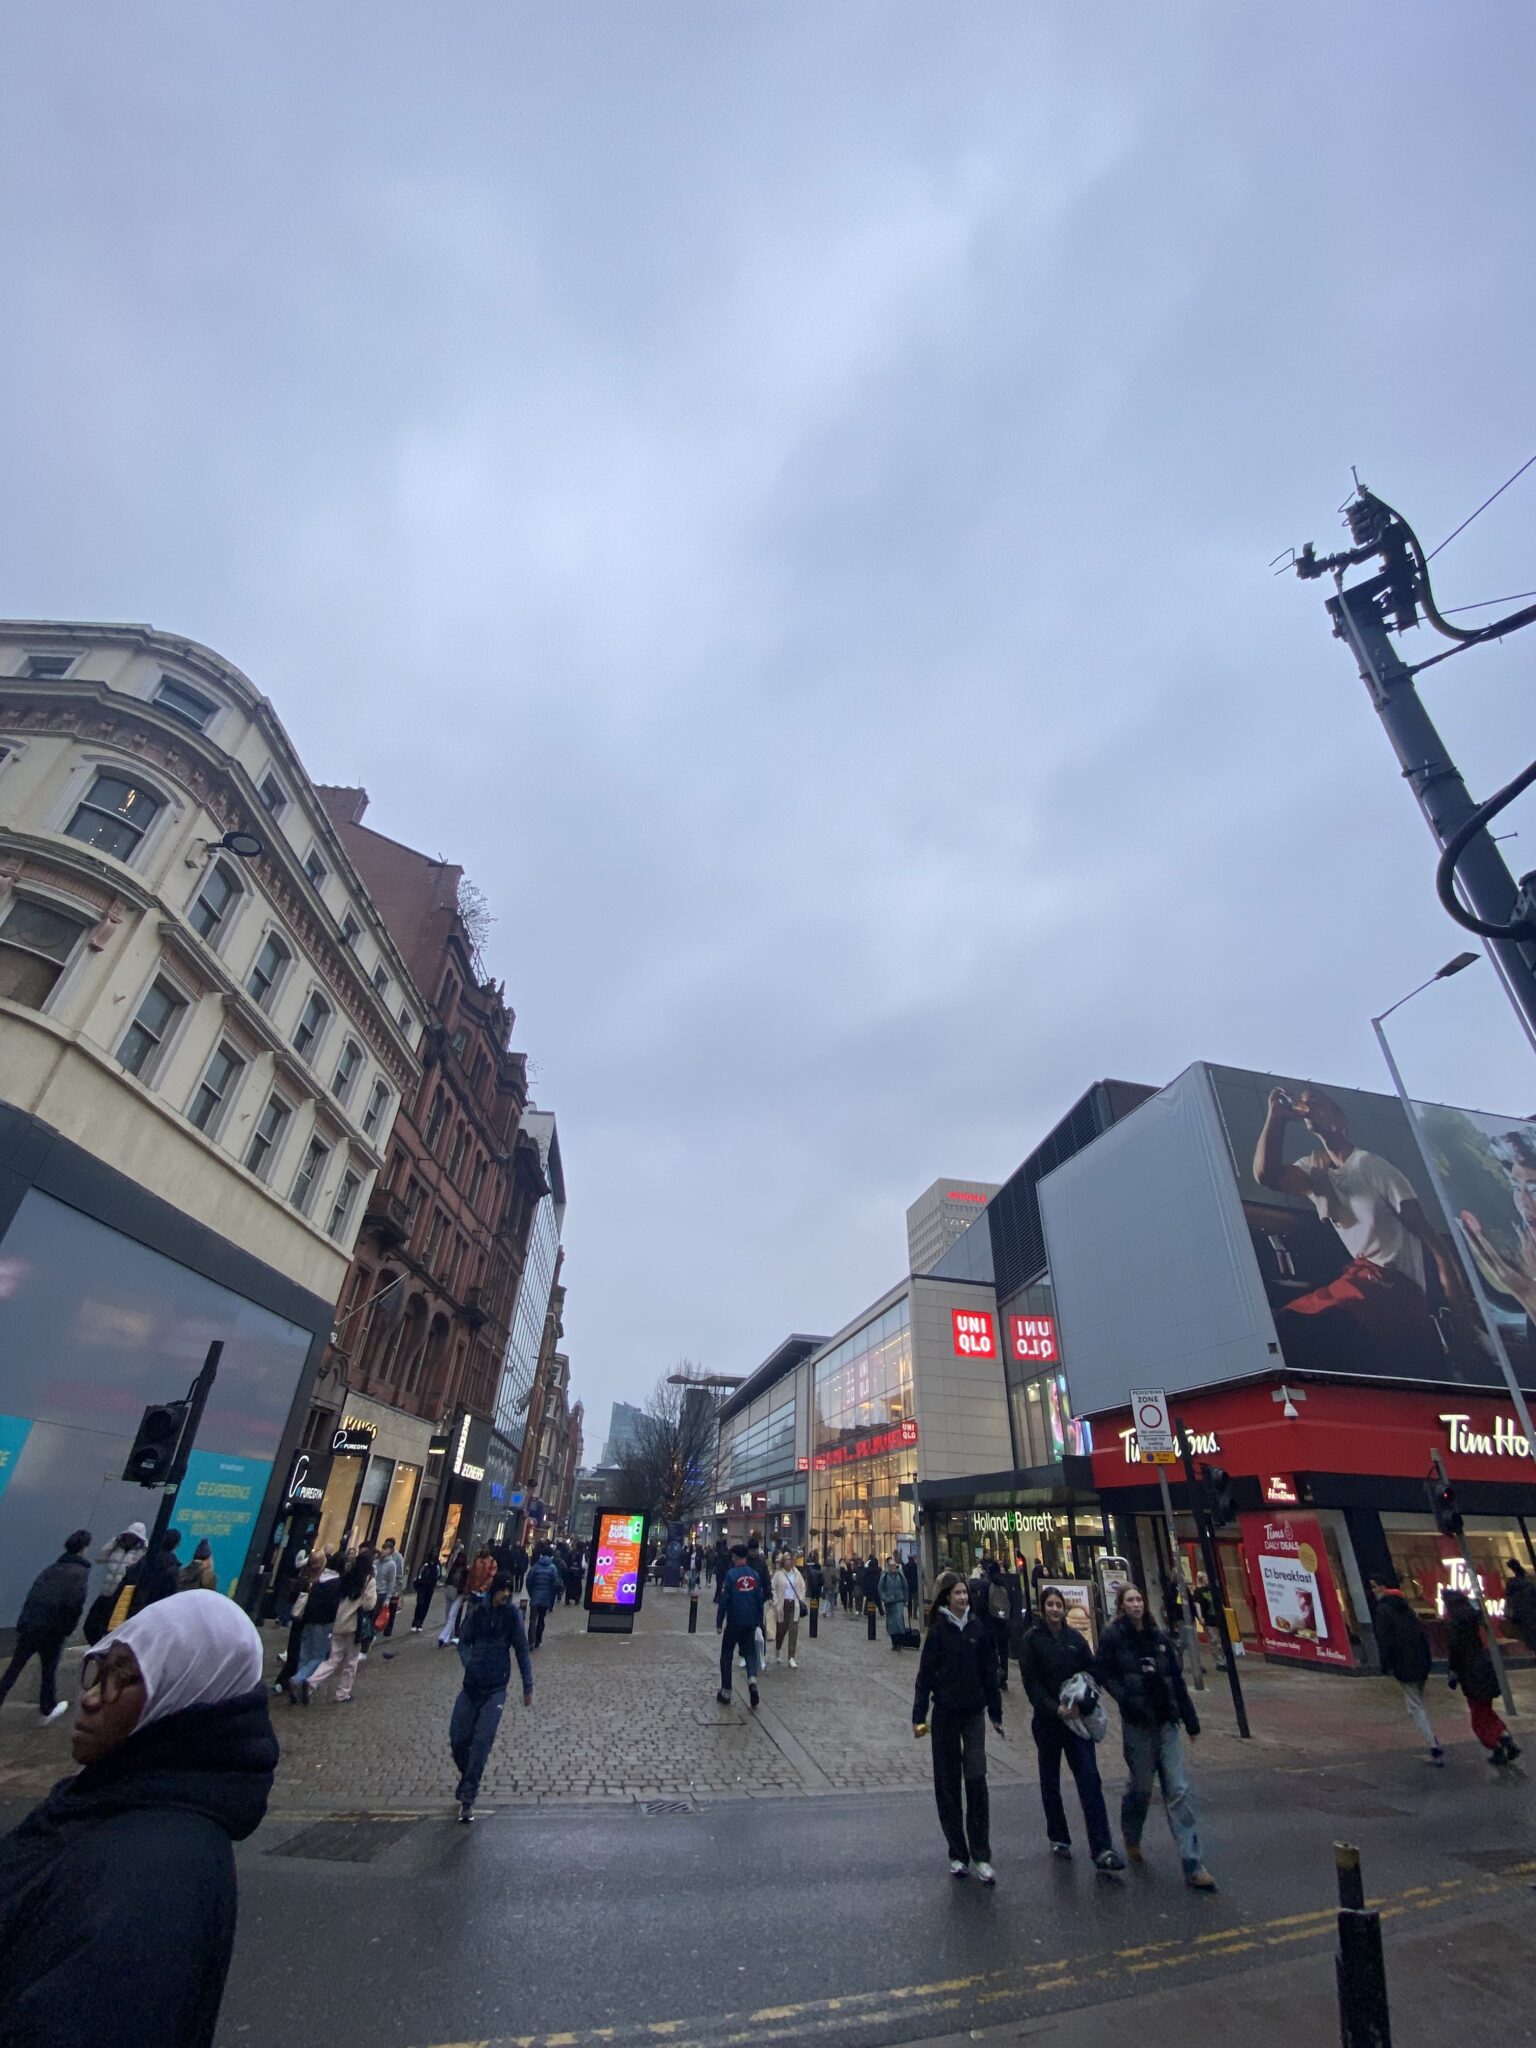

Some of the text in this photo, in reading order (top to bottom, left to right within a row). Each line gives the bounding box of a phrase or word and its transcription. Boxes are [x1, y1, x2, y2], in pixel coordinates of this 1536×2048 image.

[957, 1315, 987, 1334] UNI
[959, 1334, 991, 1354] QLO
[902, 1423, 915, 1431] UNI
[902, 1431, 916, 1439] QLO
[1439, 1414, 1493, 1456] Tim
[1270, 1477, 1287, 1490] Tim
[300, 1486, 323, 1499] PUREGYM
[1268, 1488, 1296, 1500] Hortons
[973, 1511, 1009, 1531] Holland
[1015, 1511, 1054, 1532] Barrett
[1264, 1523, 1285, 1540] Tims
[1264, 1541, 1300, 1550] DAILY DEALS
[1264, 1567, 1312, 1584] £1 breakfast
